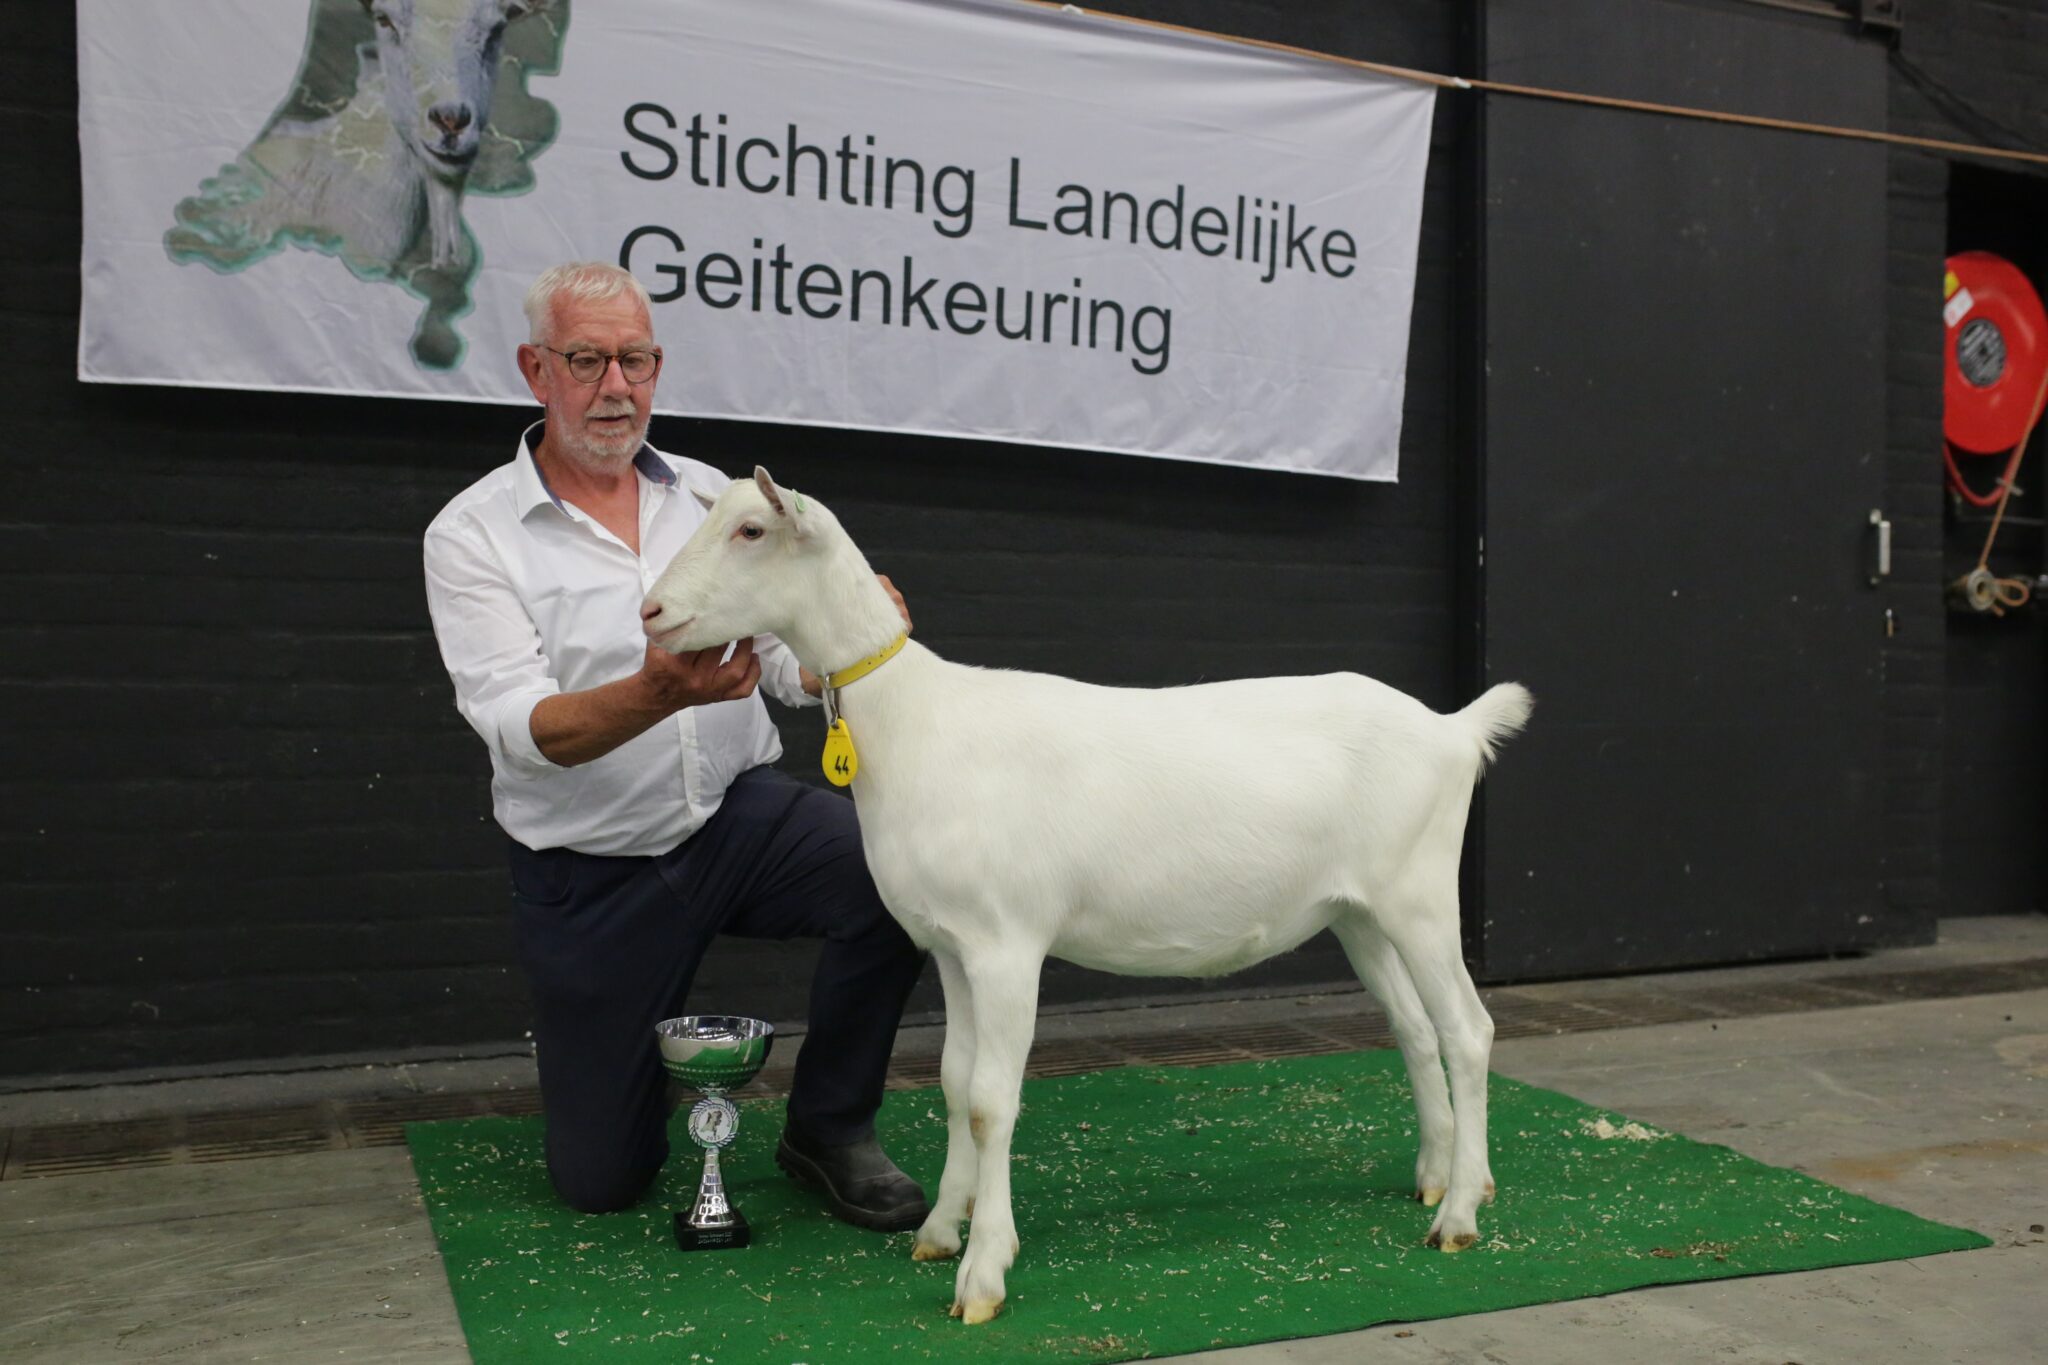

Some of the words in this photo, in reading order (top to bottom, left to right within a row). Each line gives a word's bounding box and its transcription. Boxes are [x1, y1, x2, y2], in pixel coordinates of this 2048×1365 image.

[621, 103, 975, 238] Stichting
[1008, 157, 1357, 284] Landelijke
[619, 226, 1172, 375] Geitenkeuring
[834, 755, 850, 776] 44
